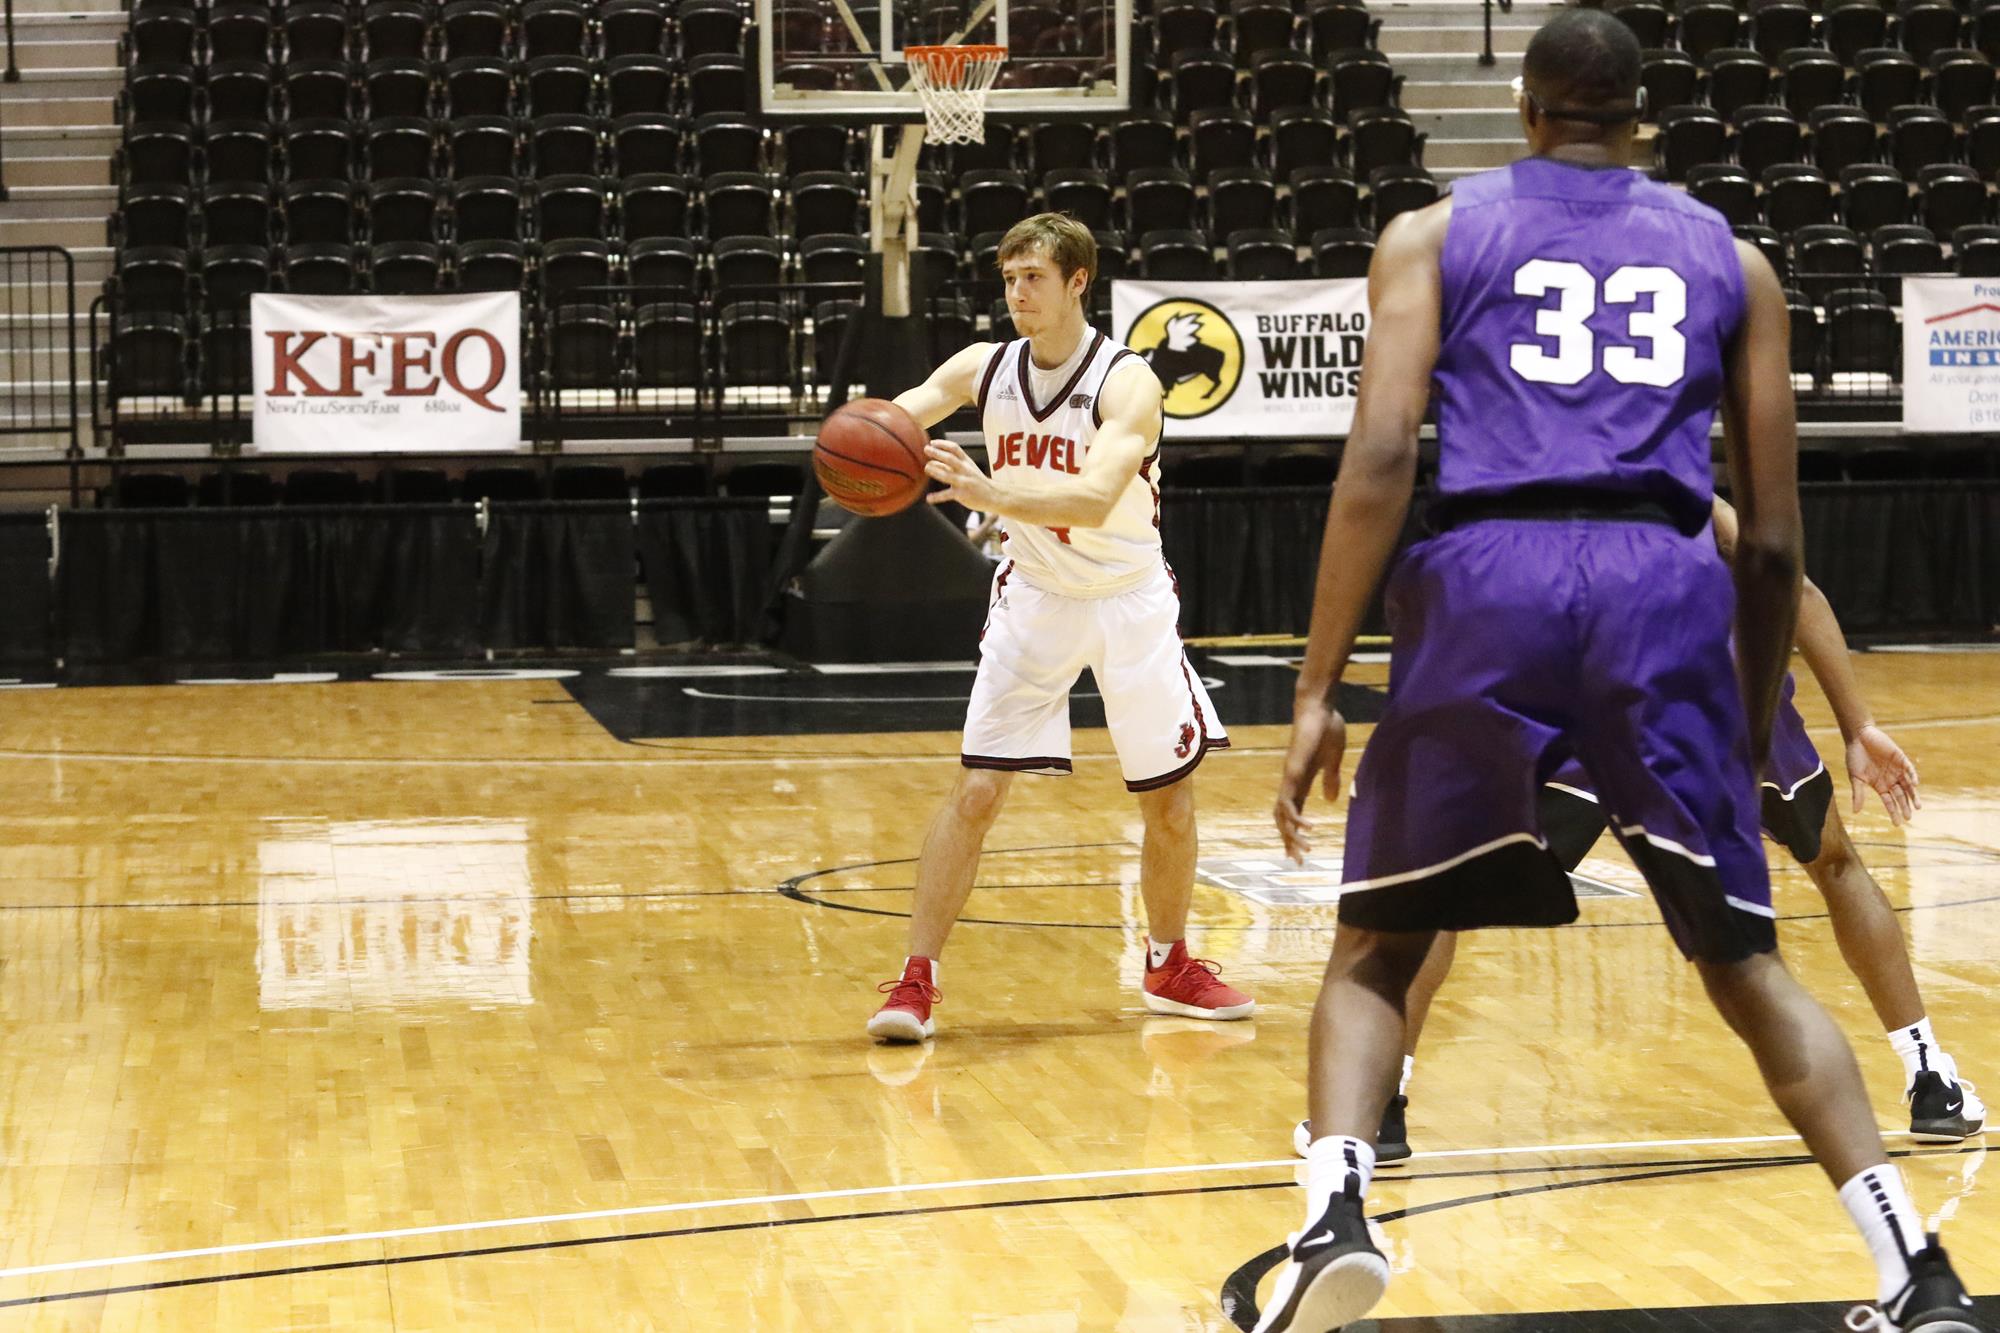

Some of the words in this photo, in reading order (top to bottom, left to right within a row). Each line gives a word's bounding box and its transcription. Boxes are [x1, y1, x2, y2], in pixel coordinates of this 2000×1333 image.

[1256, 313, 1365, 333] BUFFALO
[1510, 258, 1687, 388] 33
[265, 328, 507, 412] KFEQ
[1258, 336, 1365, 369] WILD
[993, 432, 1090, 475] JEWEL
